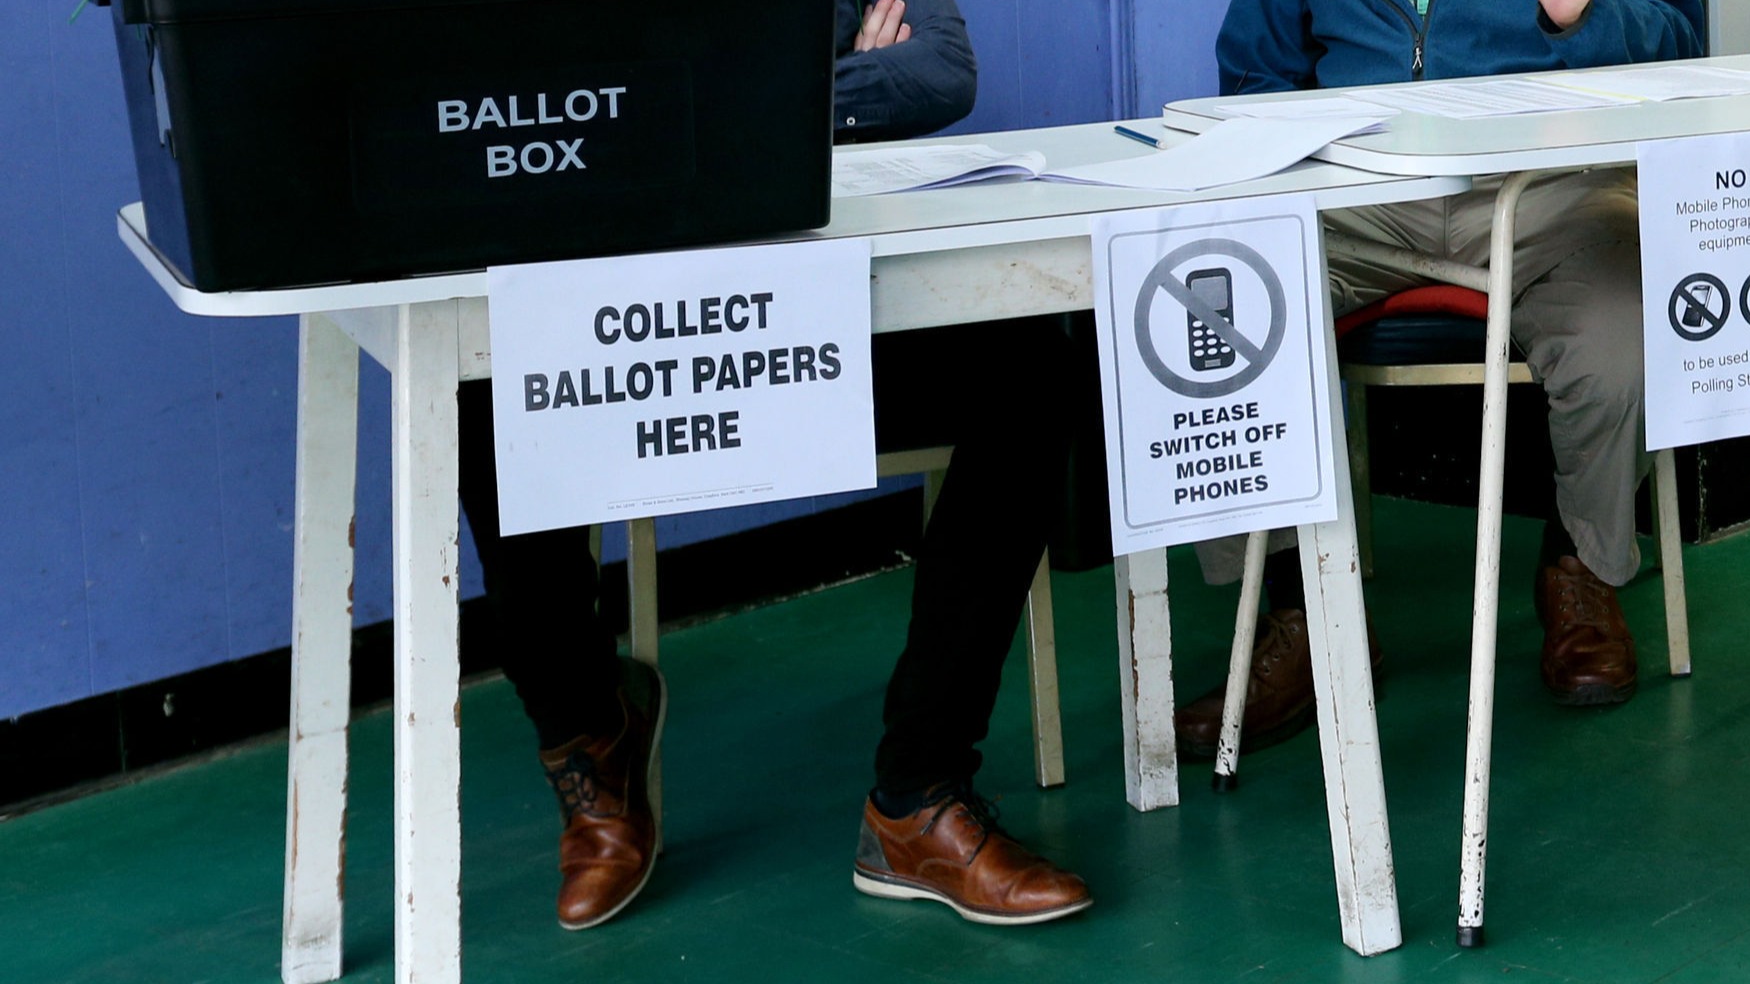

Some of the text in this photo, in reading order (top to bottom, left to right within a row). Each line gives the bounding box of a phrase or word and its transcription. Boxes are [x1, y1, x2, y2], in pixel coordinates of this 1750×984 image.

[437, 86, 628, 134] BALLOT
[486, 139, 588, 179] BOX
[1716, 169, 1747, 190] NO
[1676, 198, 1718, 216] Mobile
[594, 291, 774, 347] COLLECT
[1683, 359, 1695, 372] to
[1699, 356, 1715, 369] be
[1718, 350, 1749, 367] used
[524, 343, 842, 412] BALLOT PAPERS
[1691, 377, 1734, 395] Polling
[1173, 402, 1260, 430] PLEASE
[635, 410, 742, 460] HERE
[1149, 422, 1287, 459] SWITCH OFF
[1176, 450, 1263, 480] MOBILE
[1174, 474, 1268, 505] PHONES
